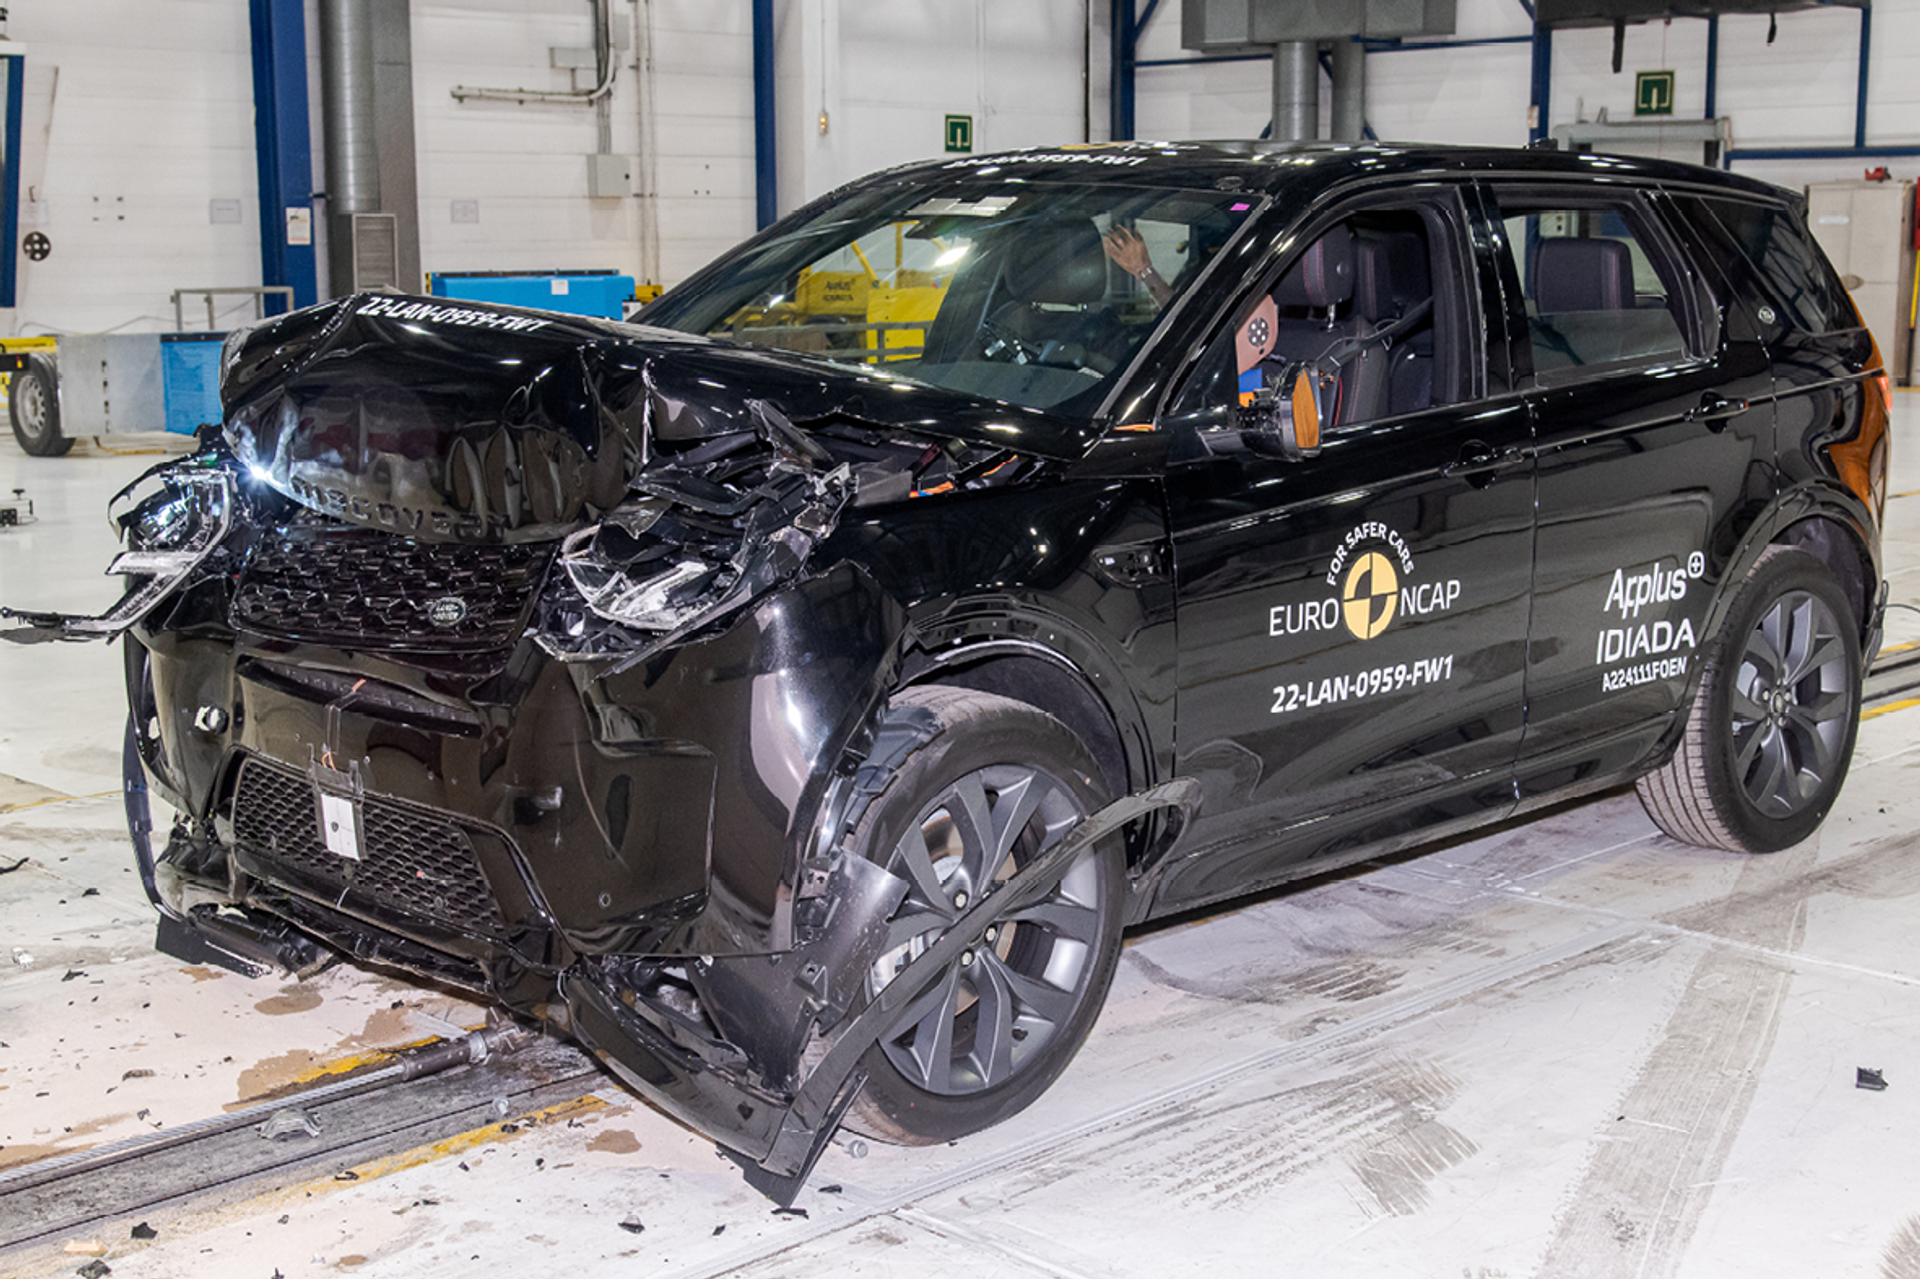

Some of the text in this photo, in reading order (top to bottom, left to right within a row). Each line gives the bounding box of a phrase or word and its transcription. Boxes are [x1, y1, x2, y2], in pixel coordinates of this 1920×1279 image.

[356, 296, 554, 332] 22-LAN-0959-FW1
[1326, 522, 1414, 586] FOR SAFER CARS
[1269, 580, 1461, 636] EURO NCAP
[1596, 618, 1696, 664] IDIADA
[1270, 654, 1453, 713] 22-LAN-0959-FW1
